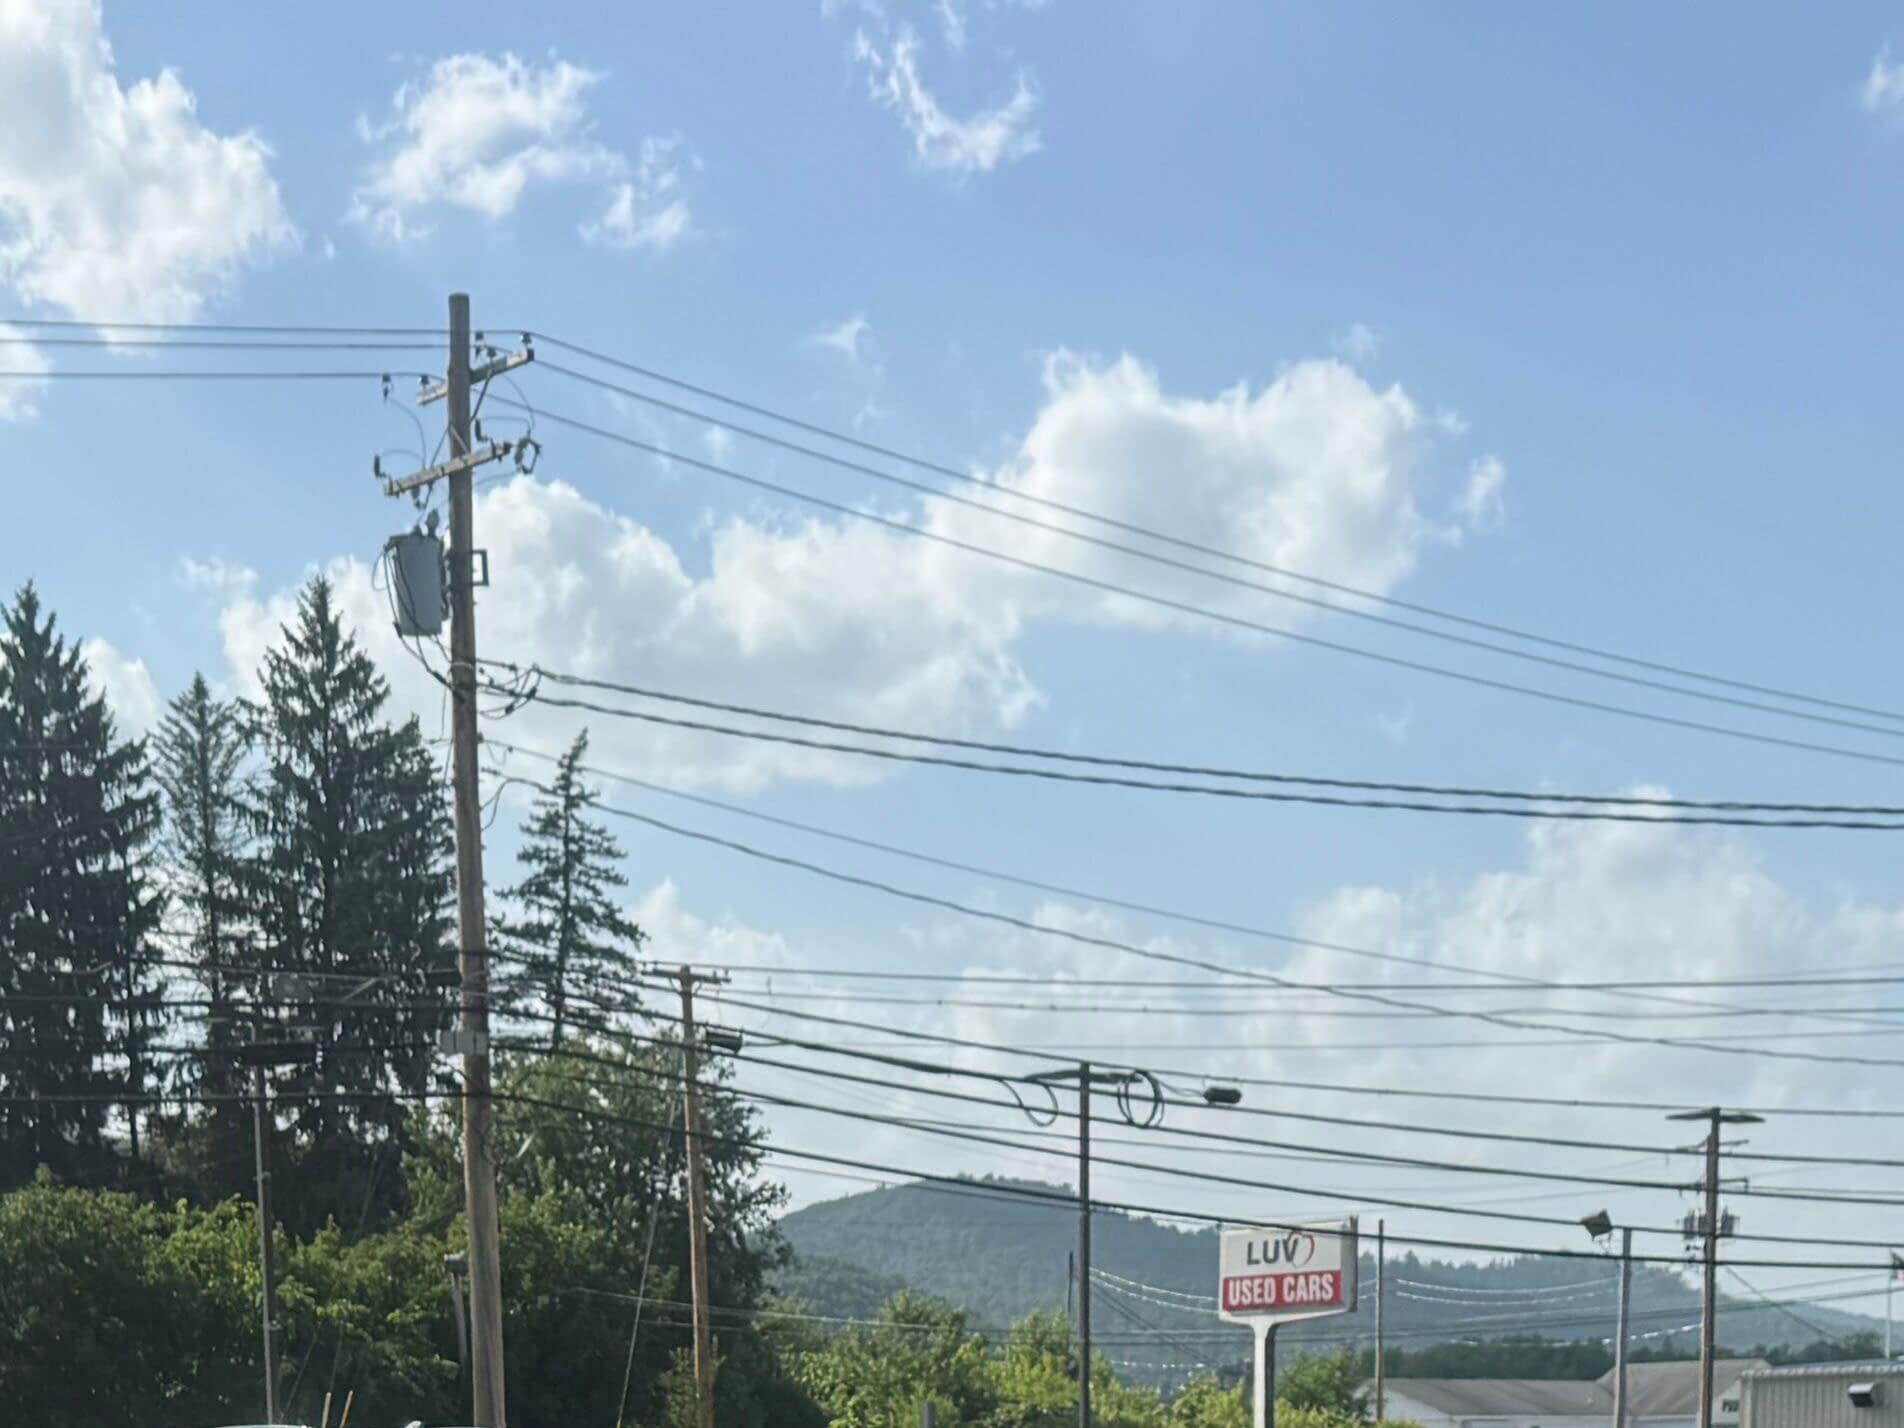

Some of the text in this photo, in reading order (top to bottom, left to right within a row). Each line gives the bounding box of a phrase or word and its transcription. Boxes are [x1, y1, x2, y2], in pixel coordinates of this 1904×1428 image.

[1247, 1238, 1299, 1265] LUV
[1228, 1273, 1334, 1307] USED CARS
